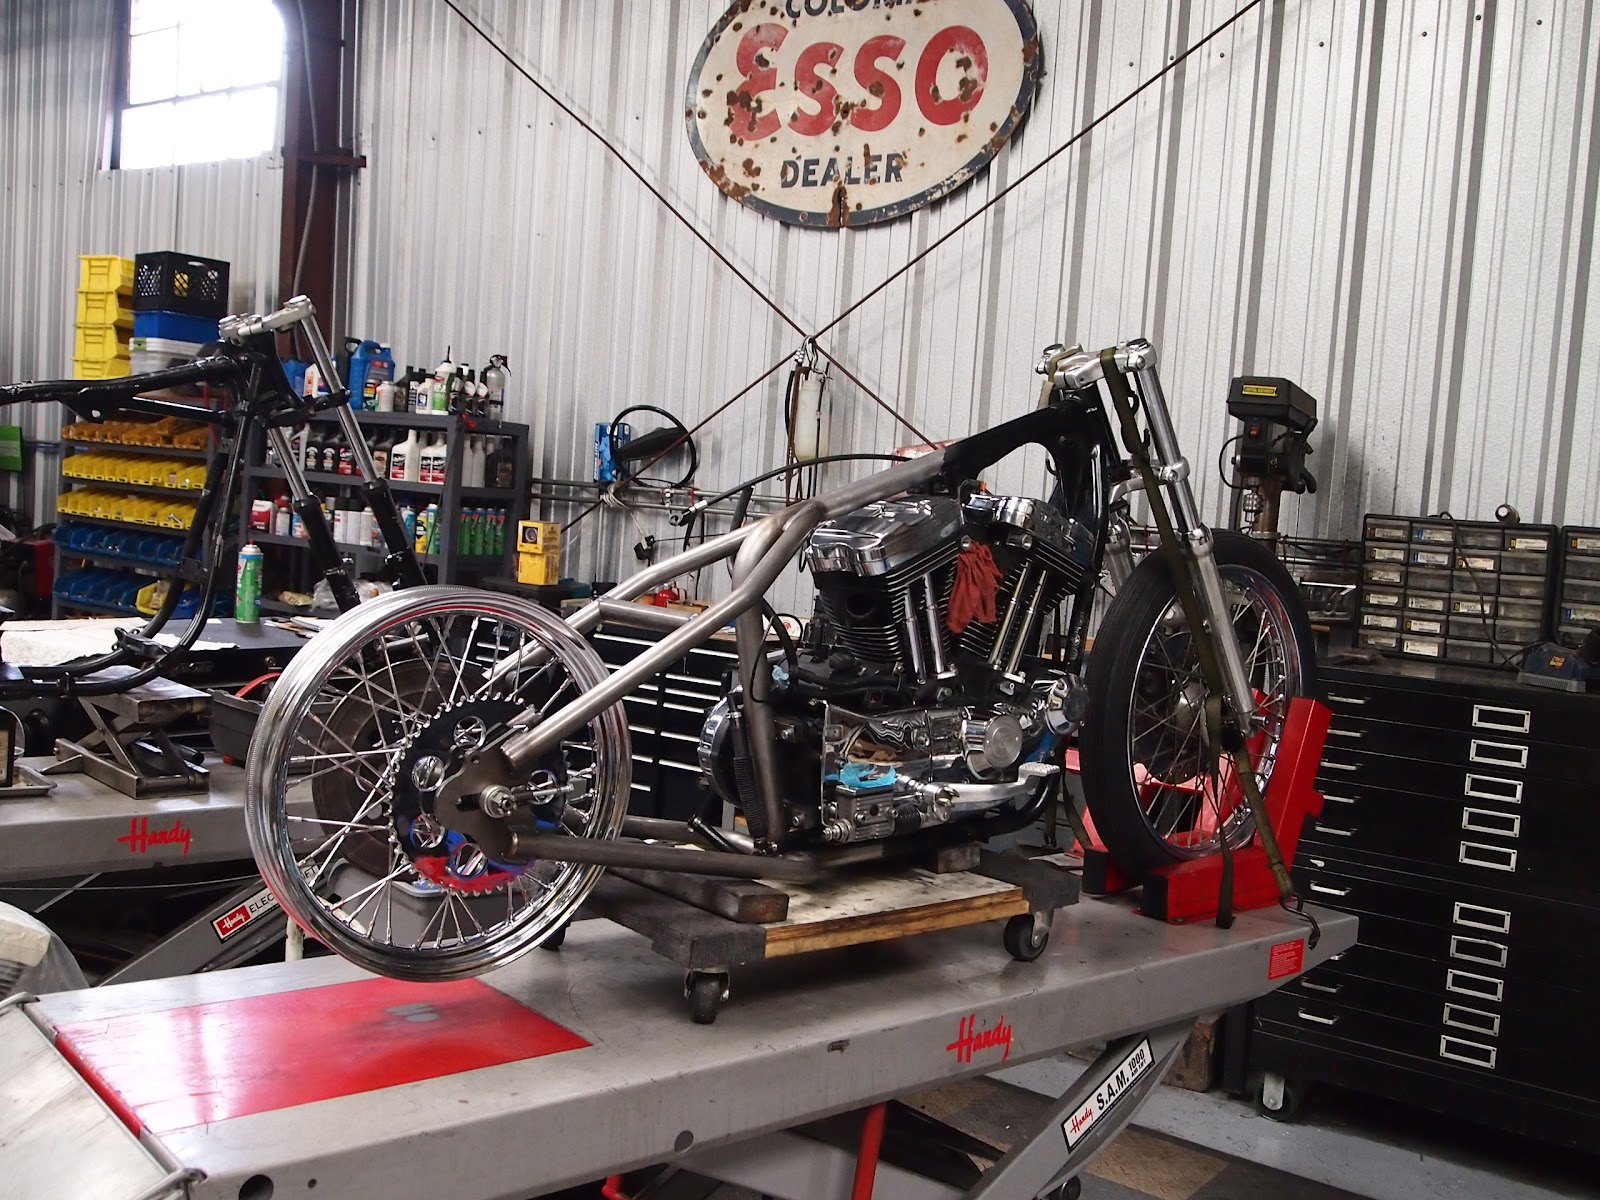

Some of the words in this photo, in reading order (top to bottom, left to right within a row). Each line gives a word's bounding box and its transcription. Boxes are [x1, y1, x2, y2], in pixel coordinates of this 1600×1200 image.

[728, 23, 988, 141] ESSO
[780, 152, 904, 188] DEALER
[117, 816, 191, 855] Handy
[222, 912, 246, 929] Handy
[946, 1013, 1012, 1063] Handy
[1128, 1048, 1145, 1072] 1000
[1069, 1107, 1094, 1134] Handy
[1096, 1069, 1130, 1111] S.A.M.
